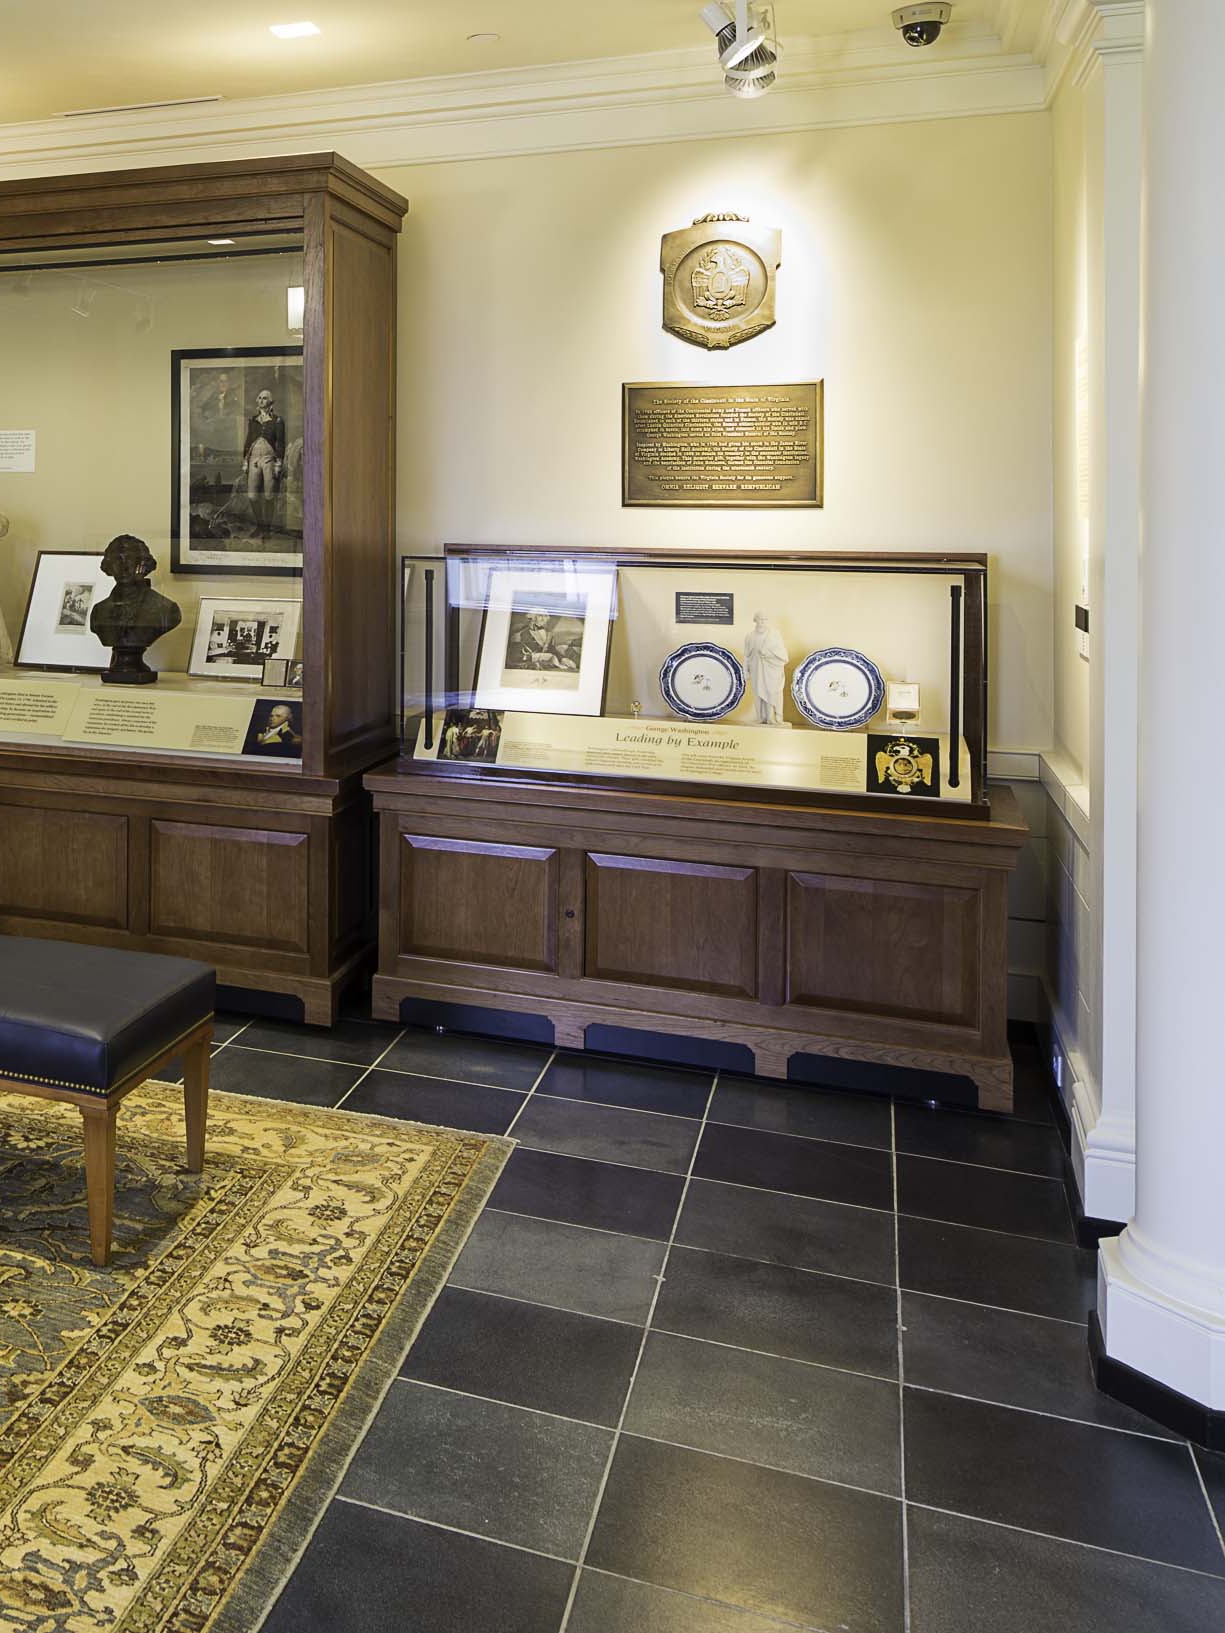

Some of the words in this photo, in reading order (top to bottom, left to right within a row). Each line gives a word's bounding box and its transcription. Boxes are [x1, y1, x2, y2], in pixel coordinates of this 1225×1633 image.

[645, 726, 669, 734] George
[670, 727, 710, 736] Washington
[615, 732, 663, 746] Leading
[667, 736, 682, 747] by
[687, 737, 740, 750] Example
